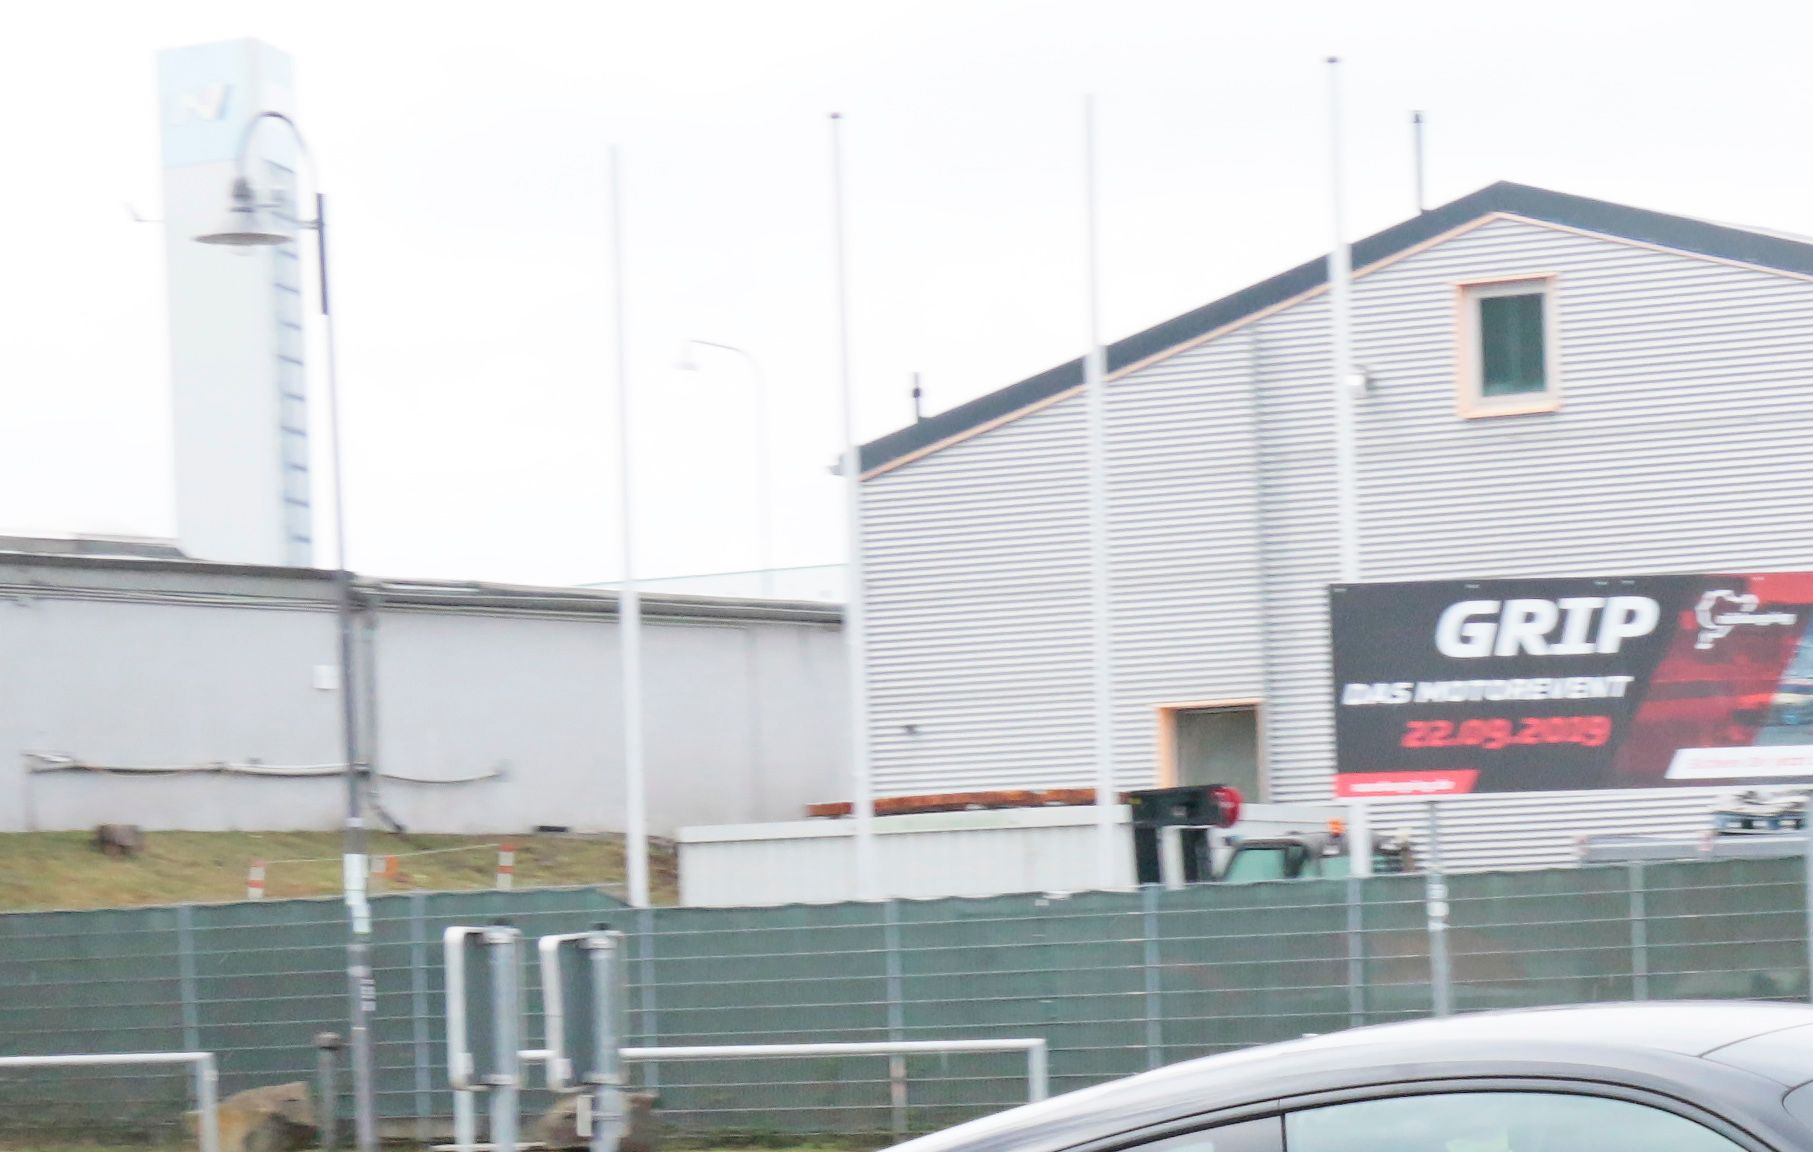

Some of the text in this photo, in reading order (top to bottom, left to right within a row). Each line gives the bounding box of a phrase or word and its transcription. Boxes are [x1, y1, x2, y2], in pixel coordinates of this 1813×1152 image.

[1434, 596, 1660, 659] GRIP
[1342, 675, 1635, 705] DAS MOTOREVENT
[1400, 715, 1612, 750] 22.09.2019
